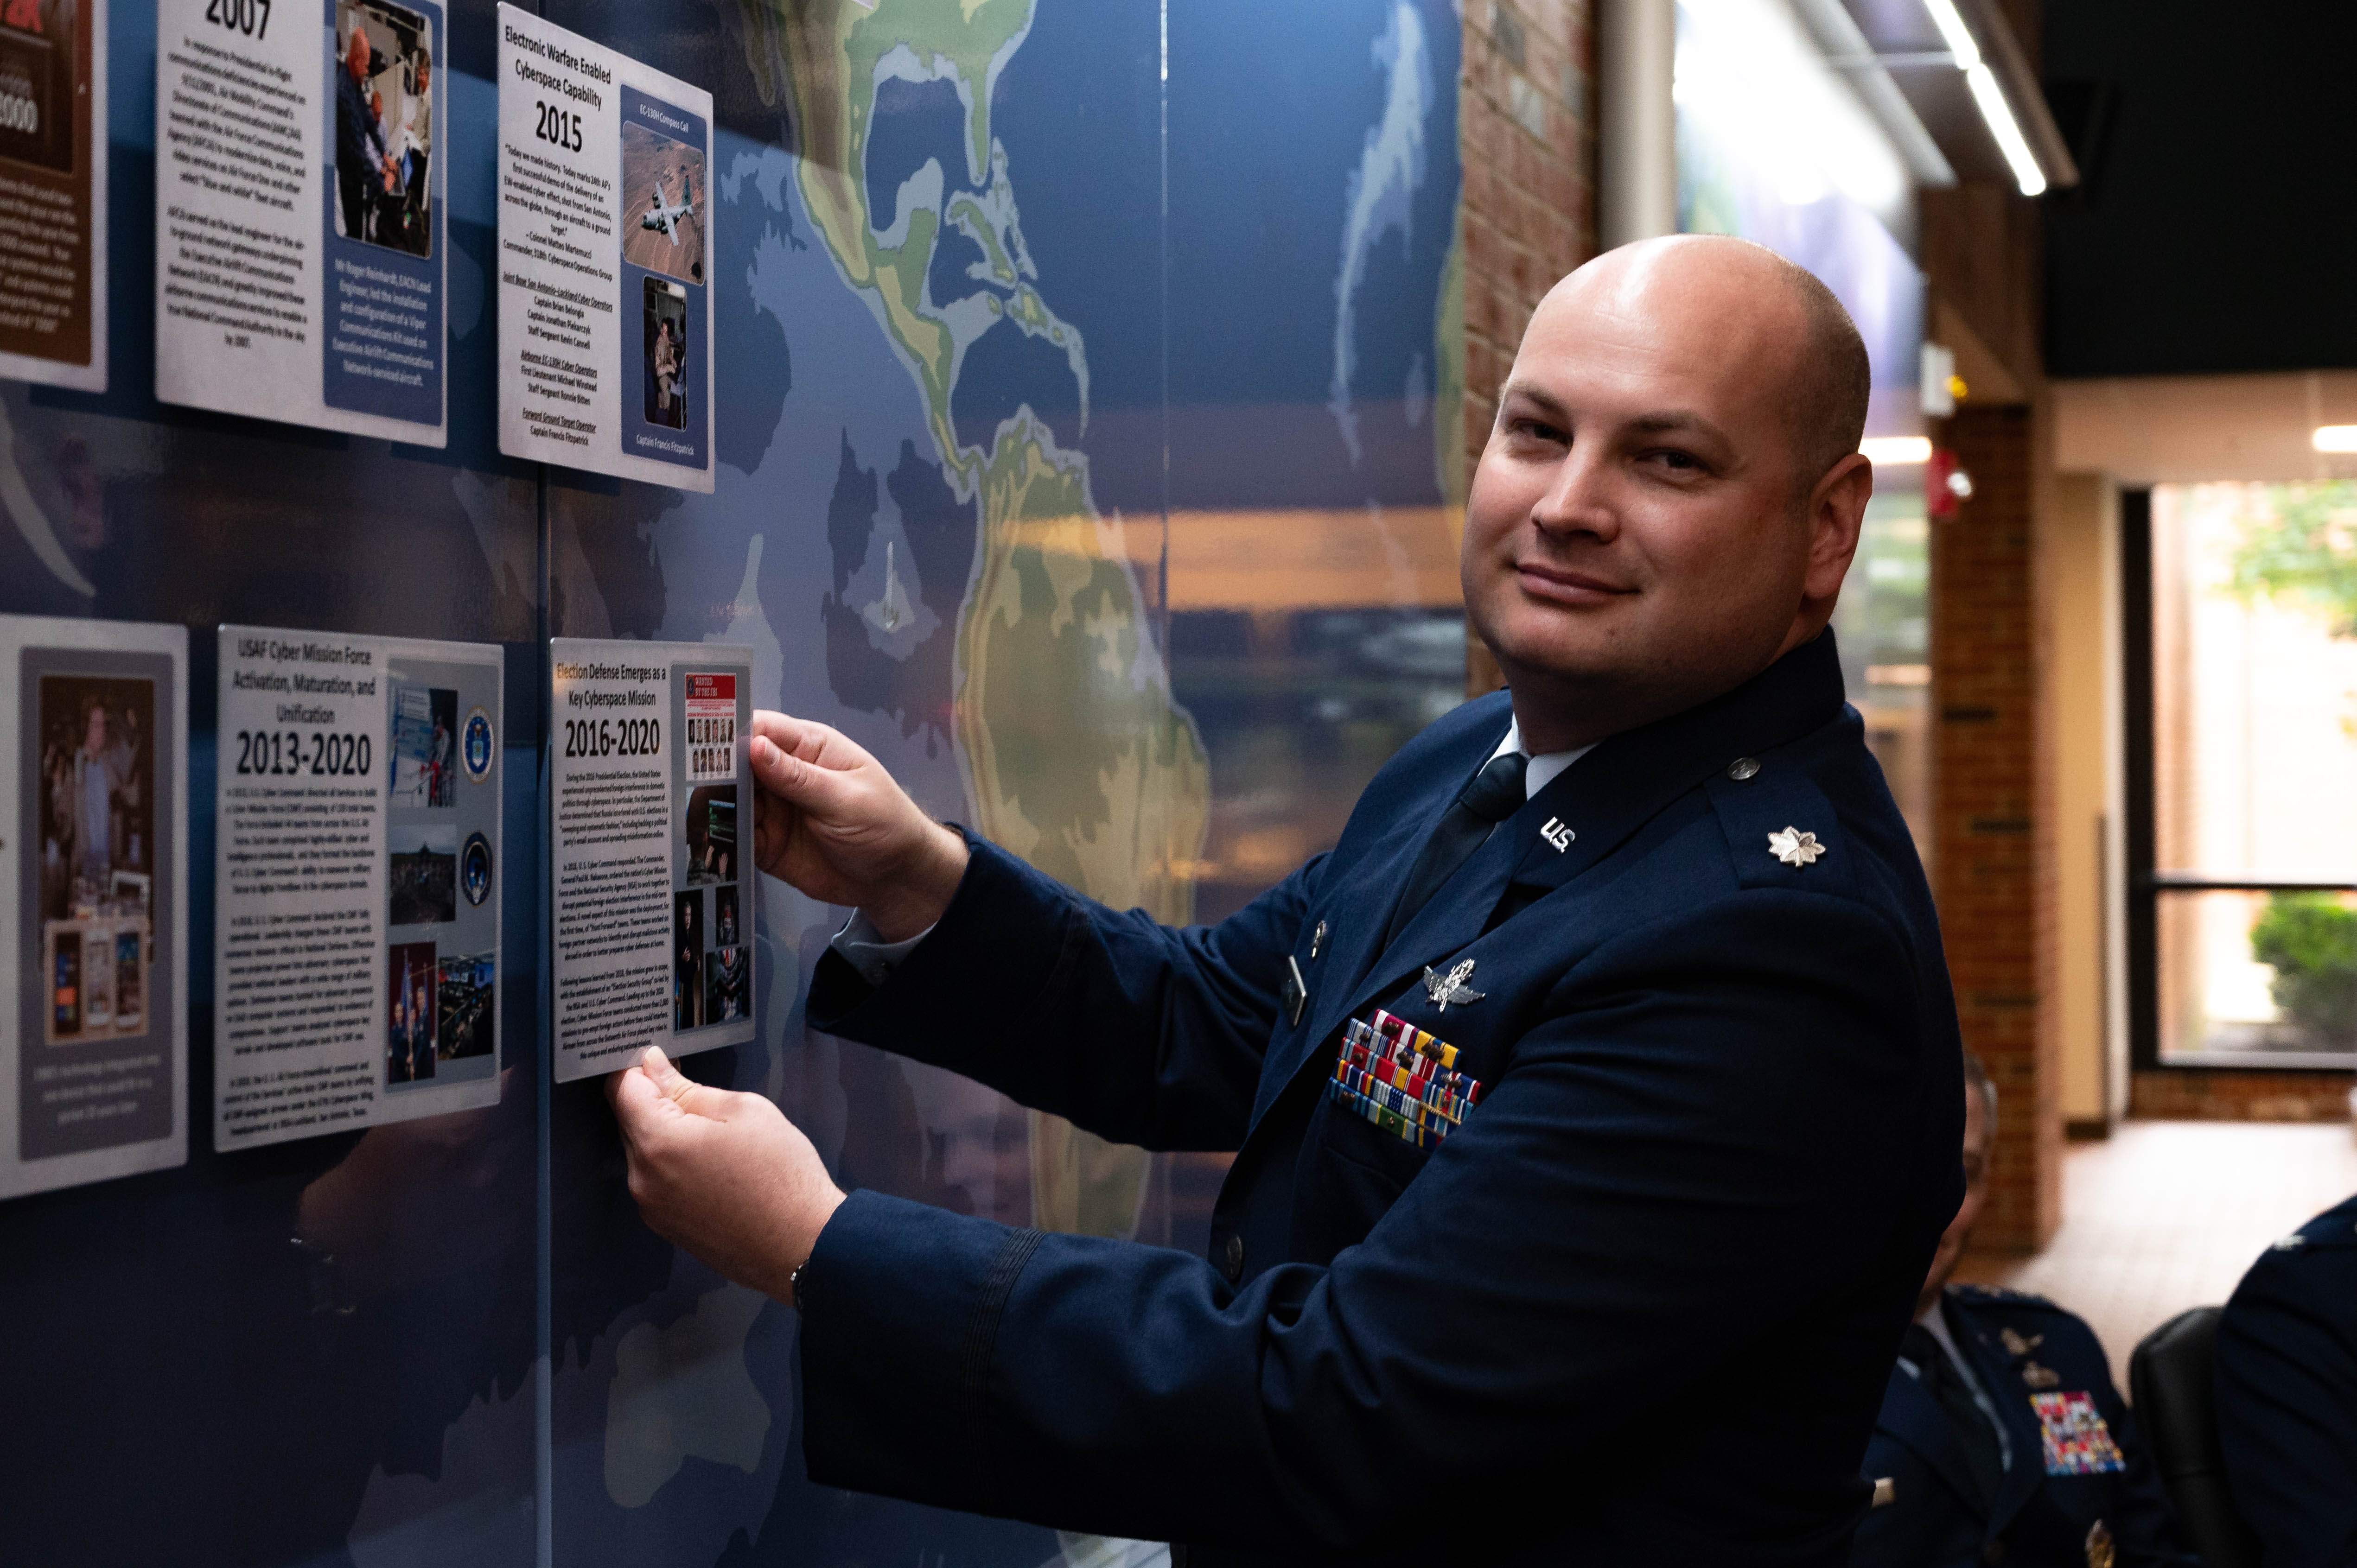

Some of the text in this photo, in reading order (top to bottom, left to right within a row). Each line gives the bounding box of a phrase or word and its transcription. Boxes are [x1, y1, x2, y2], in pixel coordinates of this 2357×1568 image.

[206, 0, 271, 40] 2007
[505, 25, 611, 84] Electronic Warfare Enabled
[516, 59, 601, 111] Cyberspace Capability
[0, 92, 38, 133] 000
[640, 104, 688, 132] EC-130H Compass Call
[536, 101, 582, 152] 2015
[522, 152, 530, 161] we
[530, 155, 544, 166] made
[544, 159, 561, 174] history.
[563, 165, 576, 179] Today
[576, 172, 591, 183] marks
[546, 175, 561, 188] demo
[574, 186, 592, 200] delivery
[519, 197, 529, 208] the
[529, 201, 543, 214] globe,
[544, 206, 562, 221] through
[569, 216, 586, 227] aircraft
[595, 224, 611, 235] ground
[532, 187, 546, 198] cyber
[561, 197, 572, 207] shot
[572, 199, 584, 210] from
[584, 203, 592, 214] San
[592, 207, 611, 222] Antonio,
[529, 231, 547, 245] Colonel
[548, 237, 565, 251] Matteo
[548, 253, 574, 269] Cyberspace
[573, 261, 598, 276] Operations
[599, 269, 612, 282] Group
[515, 274, 528, 288] Base
[527, 278, 537, 291] San
[577, 293, 591, 307] Cyber
[590, 297, 613, 312] Operators
[534, 296, 552, 309] Captain
[552, 301, 565, 312] Brian
[527, 309, 545, 322] Captain
[546, 316, 567, 328] Jonathan
[528, 325, 540, 336] Staff
[539, 328, 560, 342] Sergeant
[561, 334, 573, 345] Kevin
[521, 365, 532, 376] First
[532, 369, 556, 382] Lieutenant
[557, 375, 575, 387] Michael
[561, 360, 575, 373] Cyber
[575, 363, 597, 378] Operators
[528, 383, 540, 393] Staff
[540, 386, 560, 399] Sergeant
[542, 412, 561, 426] Ground
[560, 416, 576, 430] Target
[530, 425, 588, 446] Captain Francis Fitzpatrick
[636, 434, 694, 455] Captain Francis Fitzpatrick
[238, 638, 371, 665] USAF Cyber Mission Force
[232, 671, 375, 695] Activation, Maturation, and
[557, 662, 666, 684] Election Defense Emerges as a
[569, 690, 656, 710] Key Cyberspace Mission
[277, 704, 334, 724] Unification
[566, 719, 659, 757] 2016-2020
[237, 731, 370, 775] 2013-2020
[1541, 816, 1575, 854] US
